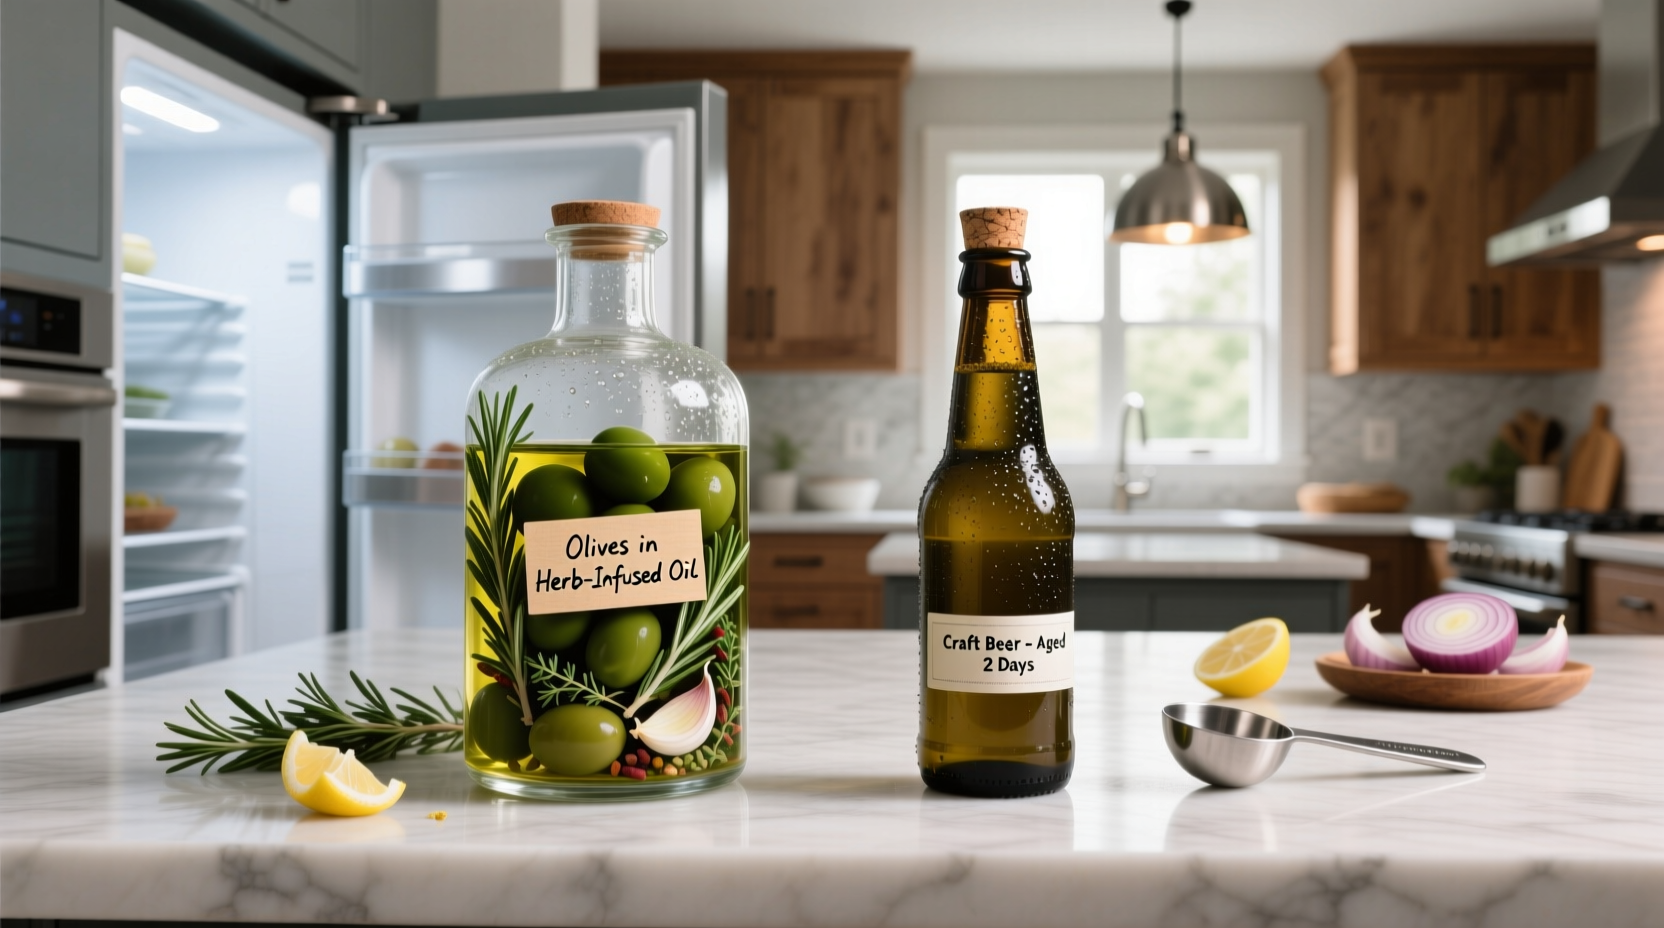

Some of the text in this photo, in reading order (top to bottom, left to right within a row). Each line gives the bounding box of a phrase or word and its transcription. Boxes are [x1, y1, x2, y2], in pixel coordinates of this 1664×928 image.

[565, 533, 658, 560] Olives in
[536, 557, 699, 594] Herb-Infused Oil
[942, 633, 981, 651] Craft
[985, 635, 1021, 652] Beer
[1036, 631, 1067, 654] Aged
[983, 656, 1035, 677] 2 Days
